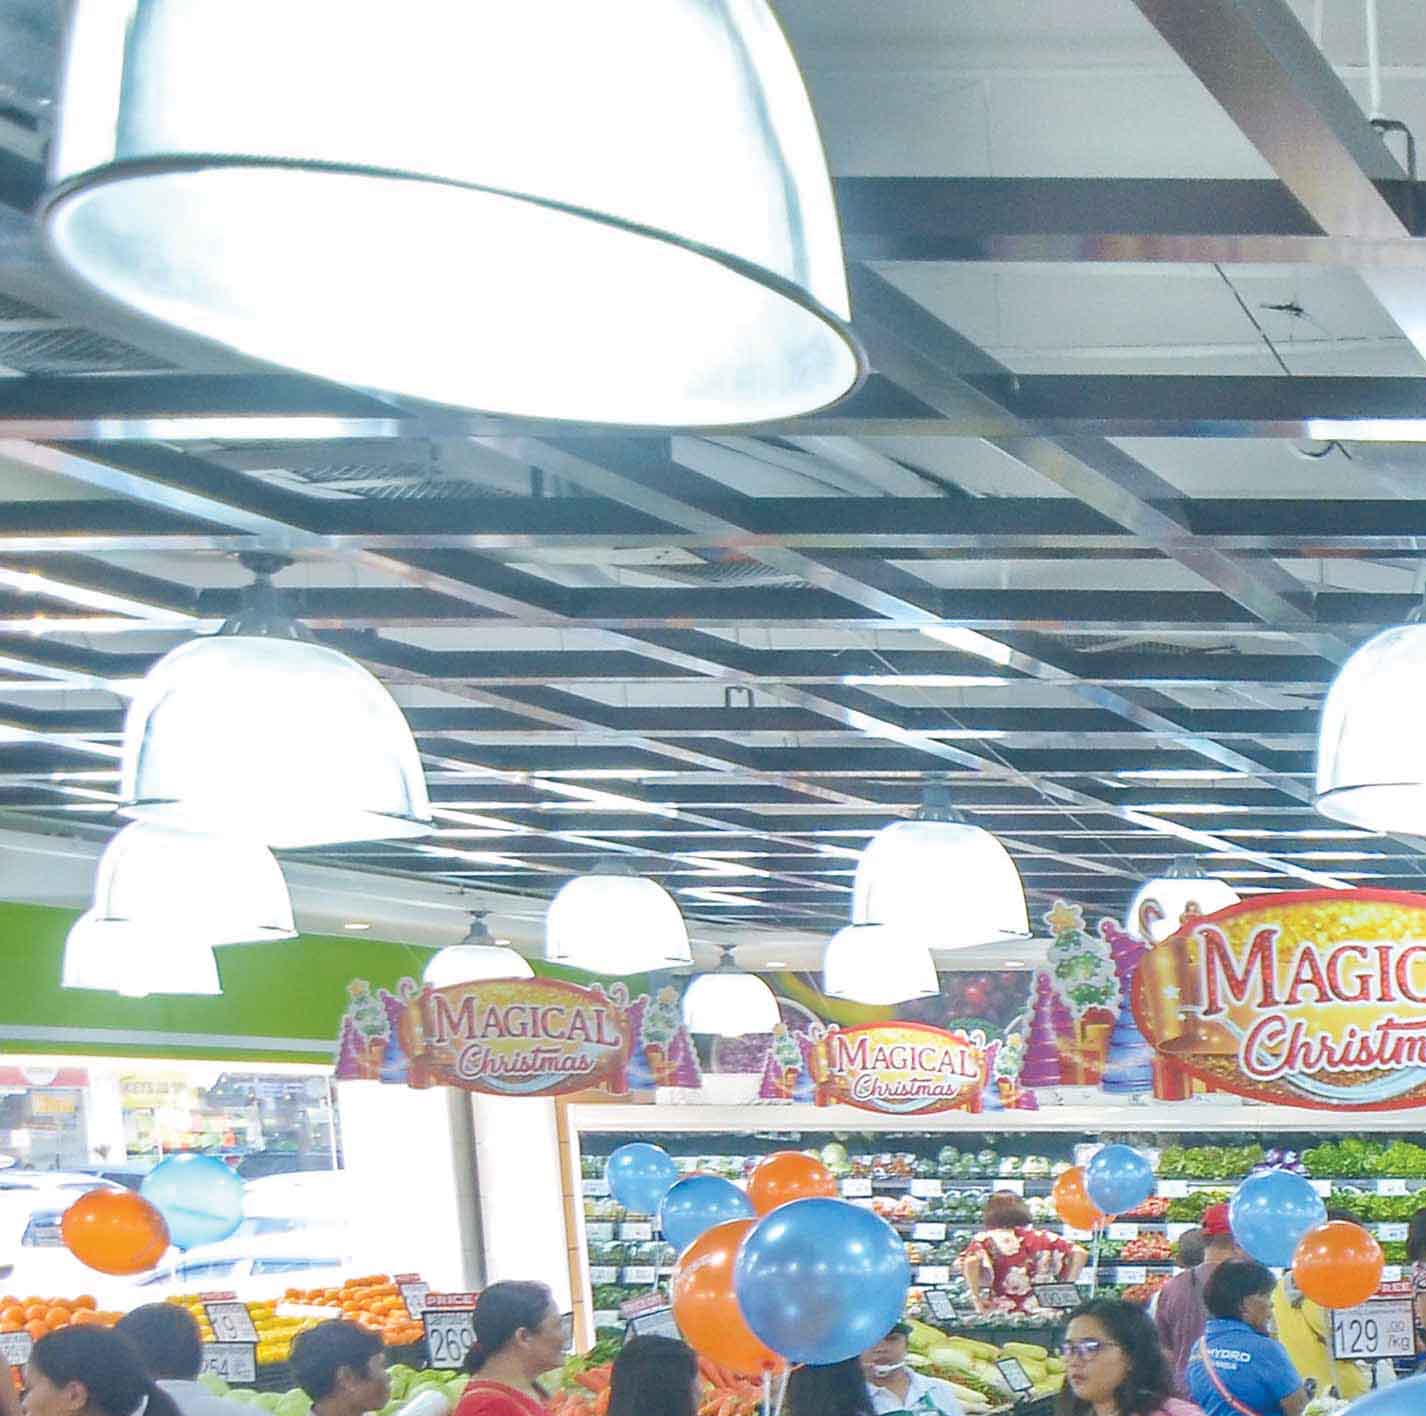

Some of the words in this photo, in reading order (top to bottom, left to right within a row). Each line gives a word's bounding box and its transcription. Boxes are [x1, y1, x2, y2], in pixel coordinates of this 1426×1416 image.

[432, 996, 620, 1047] MAGICAL
[457, 1043, 597, 1079] Christmas
[836, 1035, 978, 1078] MAGICAL
[853, 1073, 958, 1100] Christmas
[1335, 1318, 1379, 1353] 129
